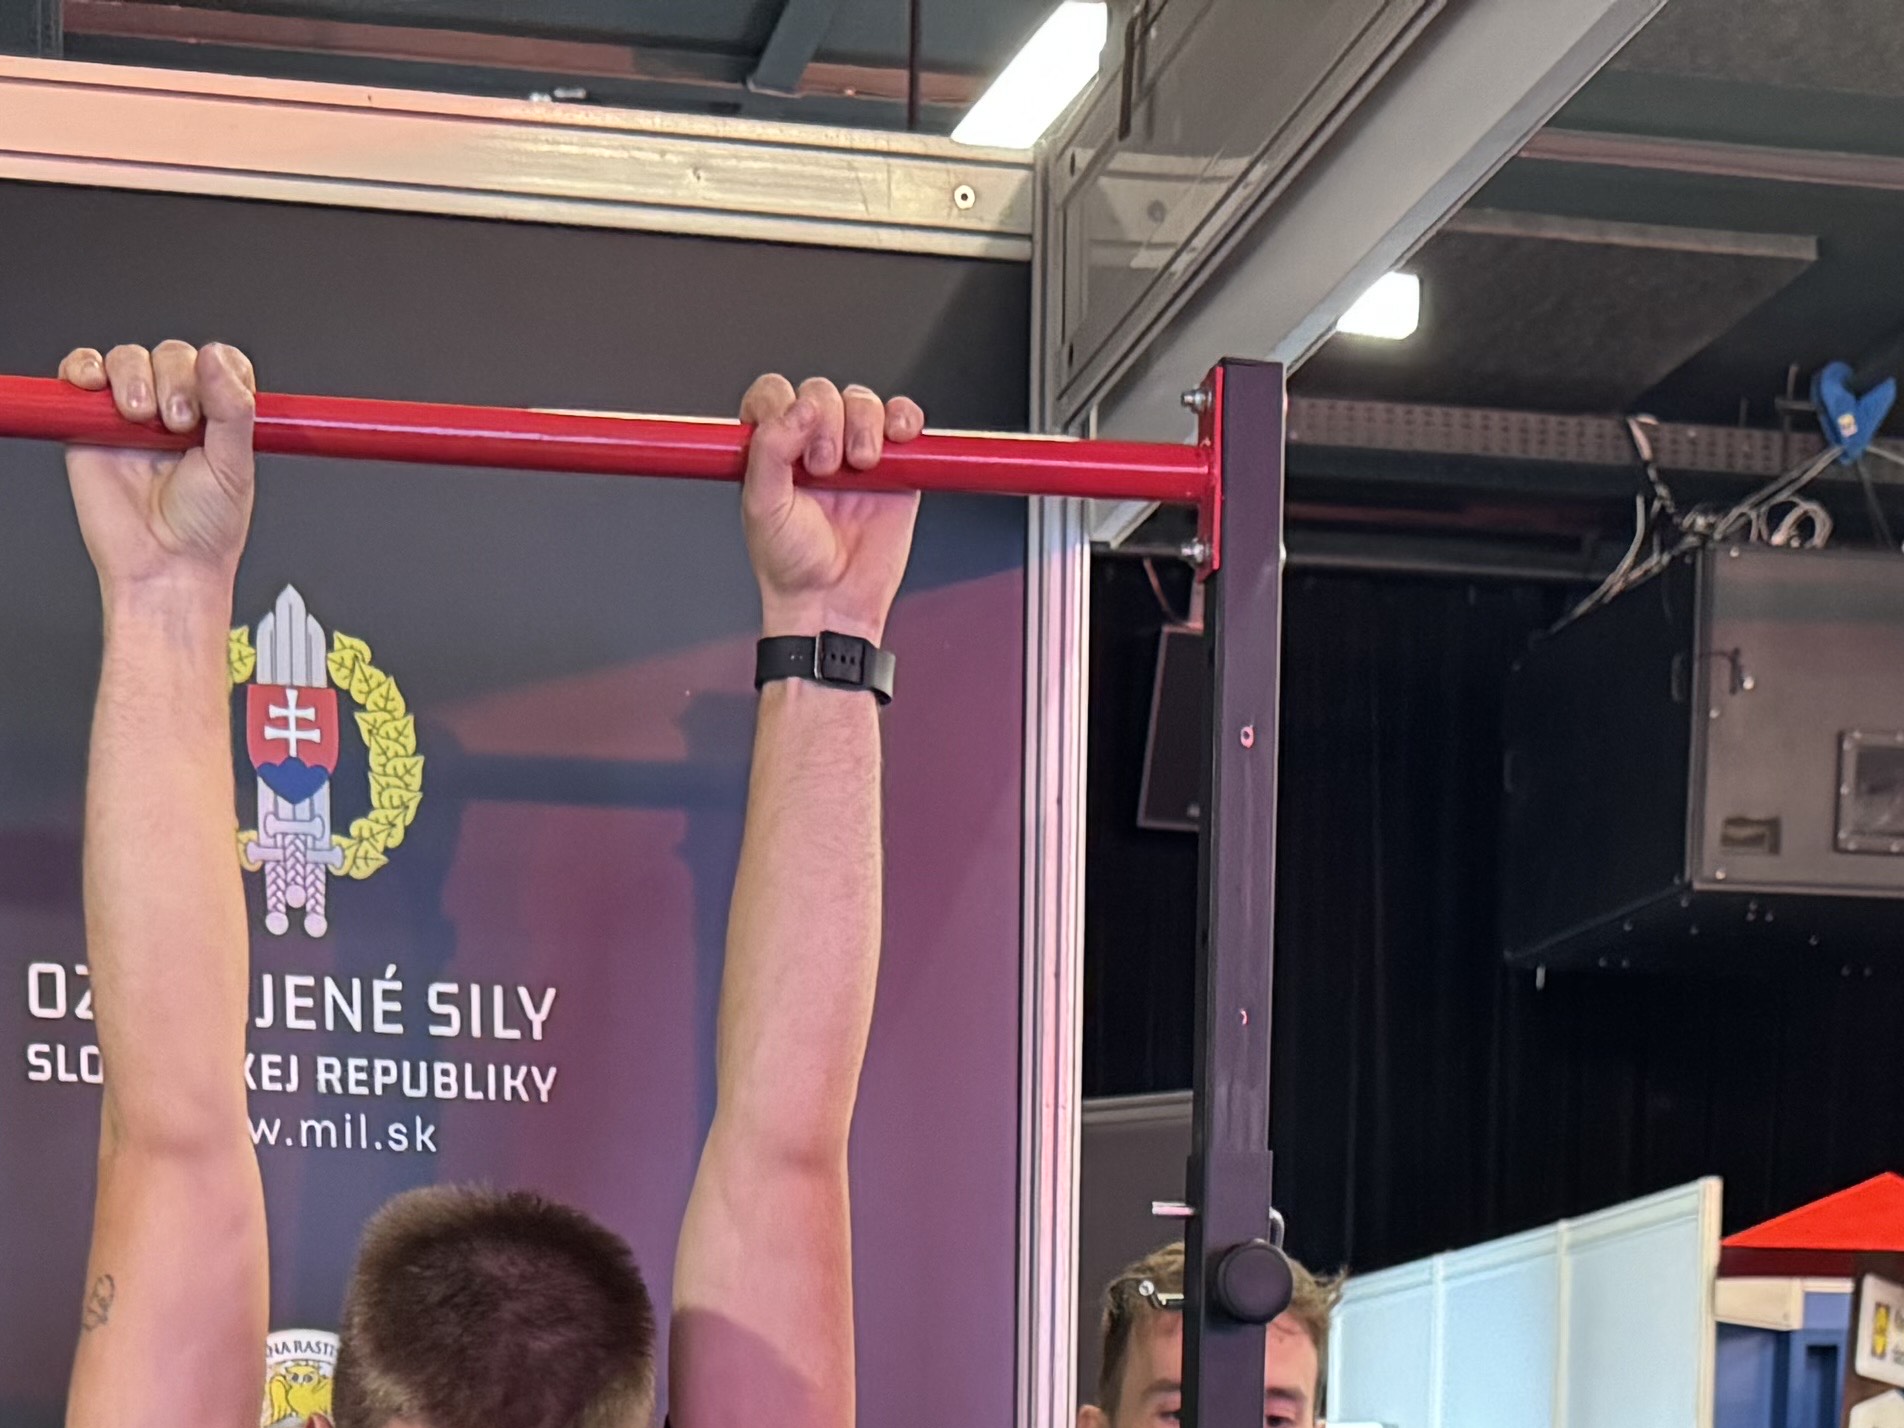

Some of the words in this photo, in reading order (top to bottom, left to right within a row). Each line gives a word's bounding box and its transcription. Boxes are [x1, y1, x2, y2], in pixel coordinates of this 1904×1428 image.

[28, 962, 404, 1035] OZJENÉ
[427, 982, 557, 1041] SILY
[27, 1043, 298, 1093] SLOKEJ
[315, 1055, 557, 1104] REPUBLIKY
[248, 1113, 438, 1153] w.mil.sk
